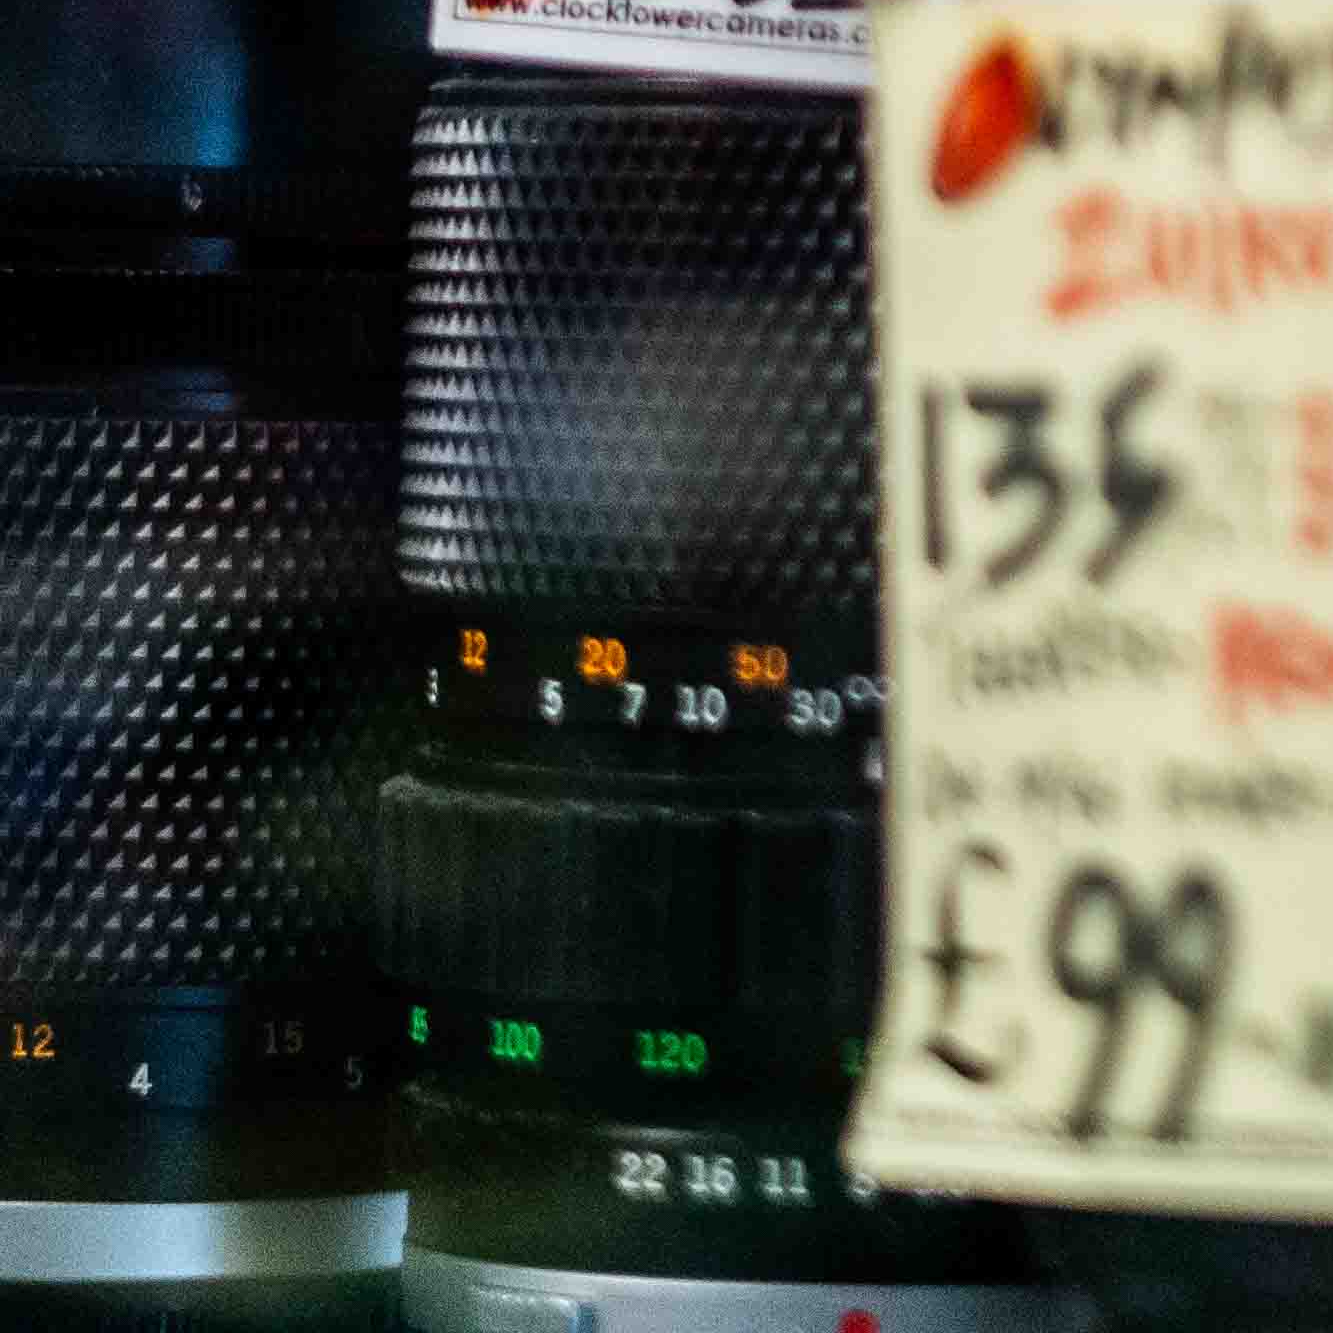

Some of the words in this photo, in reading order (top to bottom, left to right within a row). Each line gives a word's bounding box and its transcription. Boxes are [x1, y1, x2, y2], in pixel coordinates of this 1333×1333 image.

[457, 628, 489, 672] 12
[580, 637, 628, 680] 20
[538, 677, 565, 721] 5
[619, 681, 646, 723] 7
[675, 684, 728, 727] 10
[790, 687, 842, 729] 30
[12, 1022, 56, 1061] 12
[635, 1031, 707, 1072] 120
[128, 1061, 153, 1096] 4
[614, 1150, 668, 1200] 22
[682, 1153, 739, 1202] 16
[757, 1155, 809, 1200] 11
